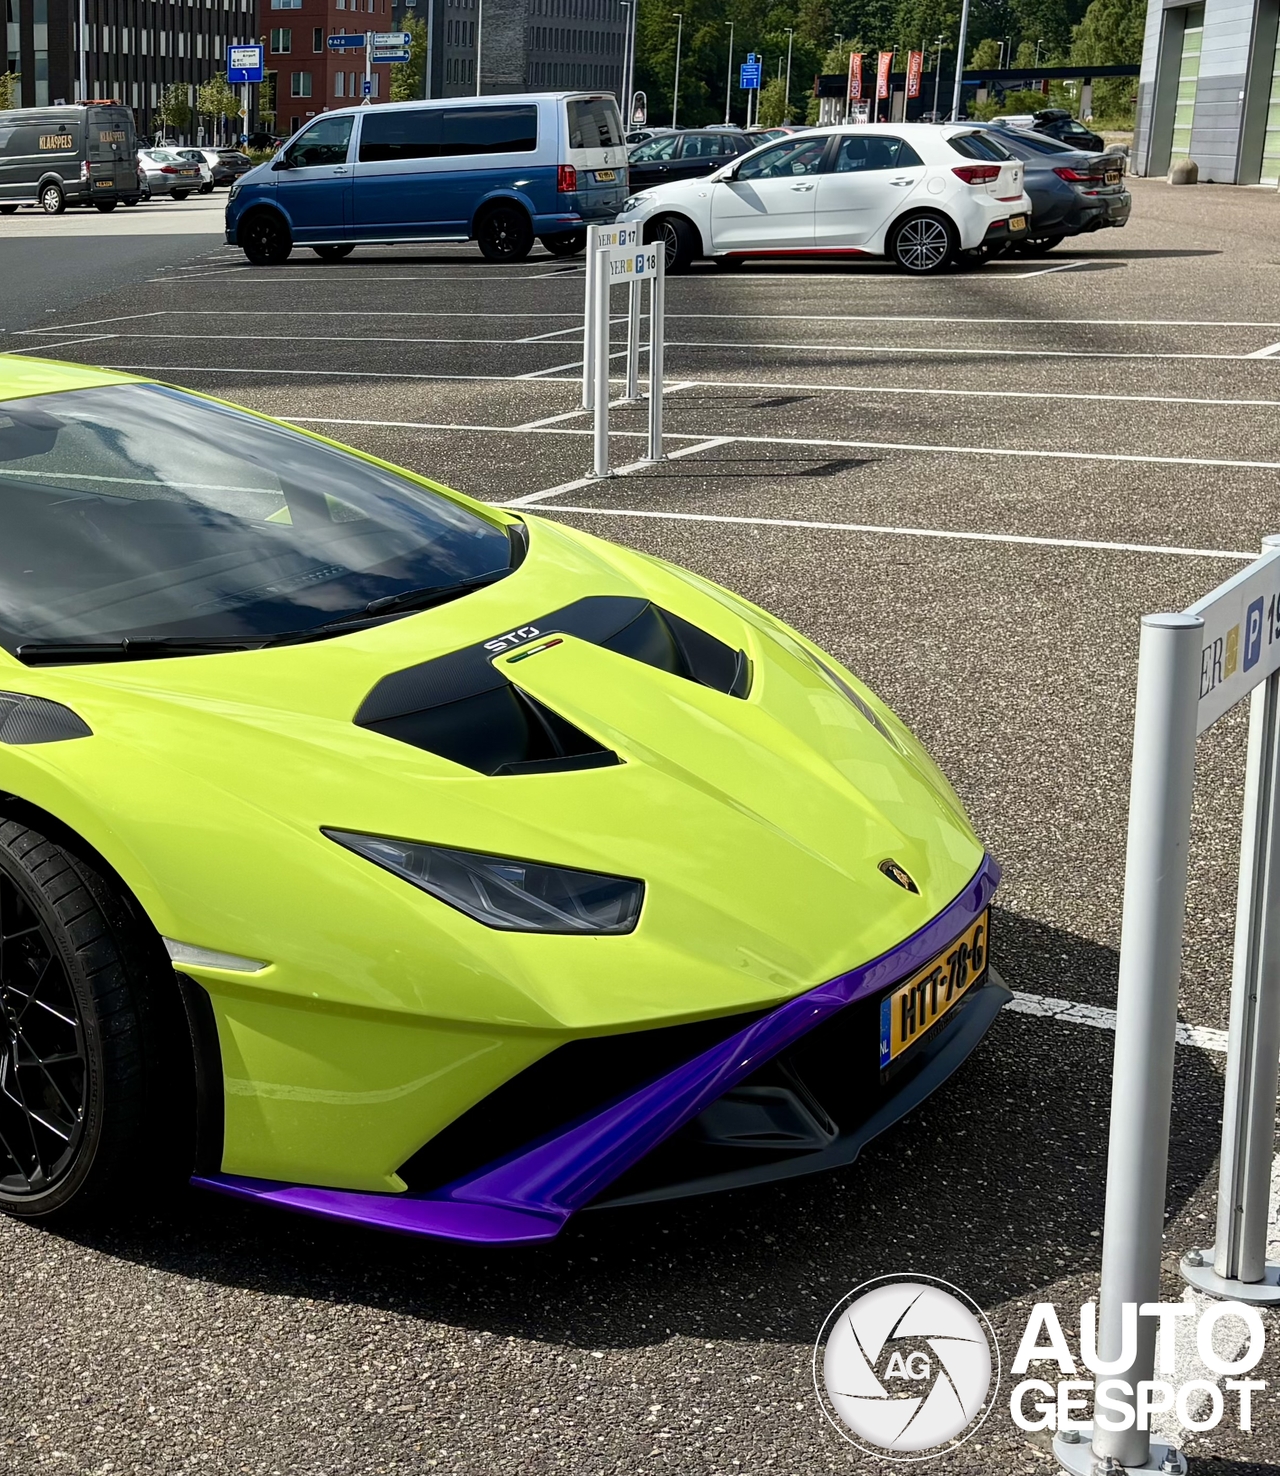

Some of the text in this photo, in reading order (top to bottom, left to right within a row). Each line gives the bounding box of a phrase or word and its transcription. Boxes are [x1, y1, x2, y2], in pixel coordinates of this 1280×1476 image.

[598, 231, 636, 247] YER P 17
[610, 255, 656, 275] YER P 18
[483, 627, 540, 651] STO
[1199, 637, 1224, 700] ER
[1247, 609, 1260, 660] P
[901, 925, 984, 1042] HTT-78-G
[880, 1039, 889, 1057] NL
